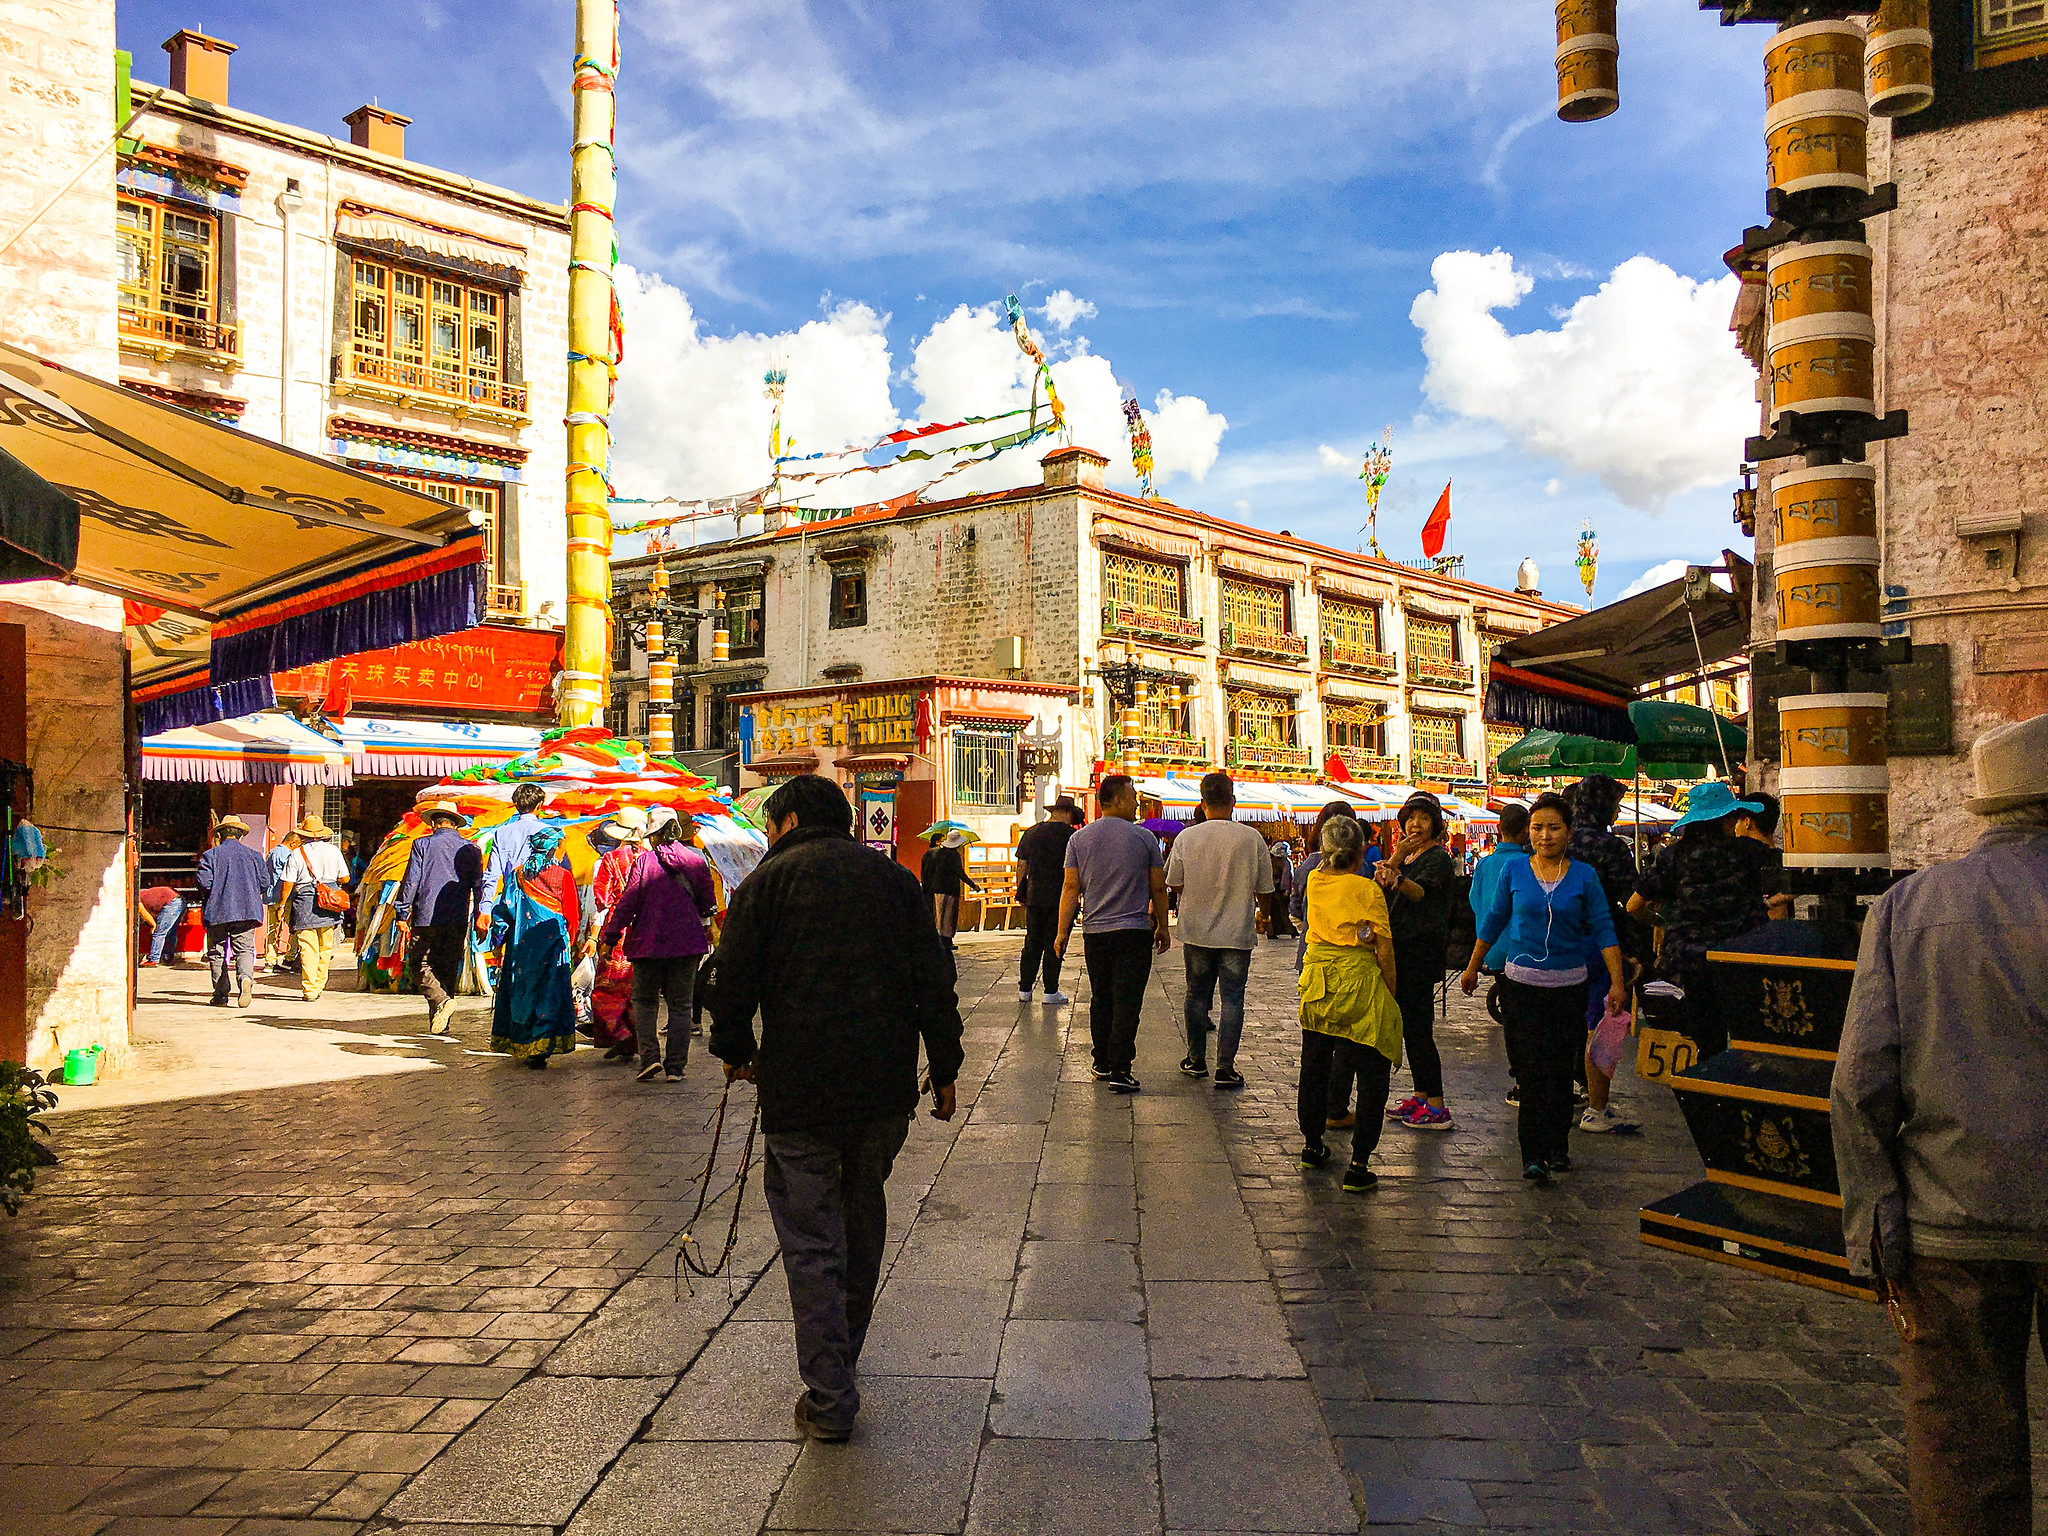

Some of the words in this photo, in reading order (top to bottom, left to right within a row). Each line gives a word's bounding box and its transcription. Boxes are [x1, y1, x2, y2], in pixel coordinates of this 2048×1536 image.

[504, 667, 551, 681] 第二分公
[858, 695, 910, 720] PUBLIC
[760, 723, 847, 751] 公共卫生间
[858, 721, 913, 745] TOILET
[1647, 1042, 1692, 1077] 50
